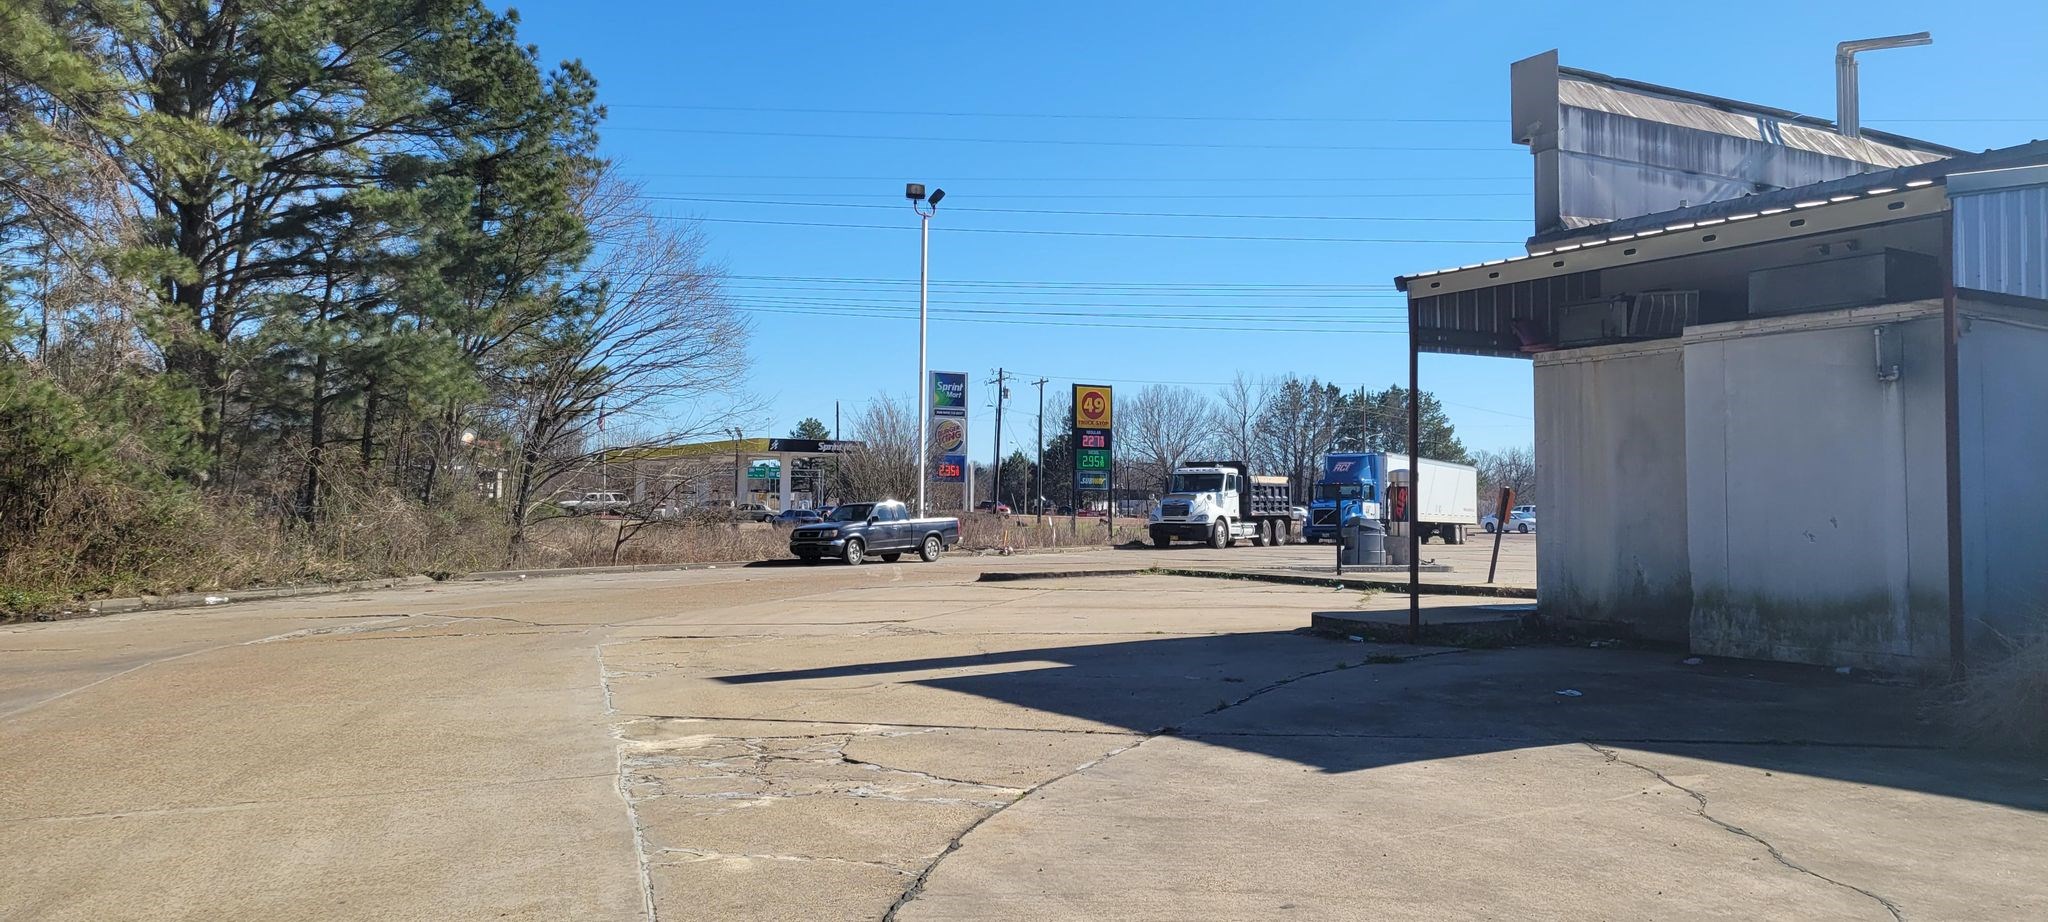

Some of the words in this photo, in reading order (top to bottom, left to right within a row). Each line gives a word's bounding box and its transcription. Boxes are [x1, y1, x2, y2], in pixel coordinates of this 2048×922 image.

[937, 381, 964, 393] Sprint
[946, 391, 962, 399] Mart
[1083, 397, 1105, 413] 49
[938, 425, 961, 437] BURGER
[939, 430, 962, 443] KING
[818, 442, 842, 452] Sprint
[1080, 477, 1106, 485] SUBWAY
